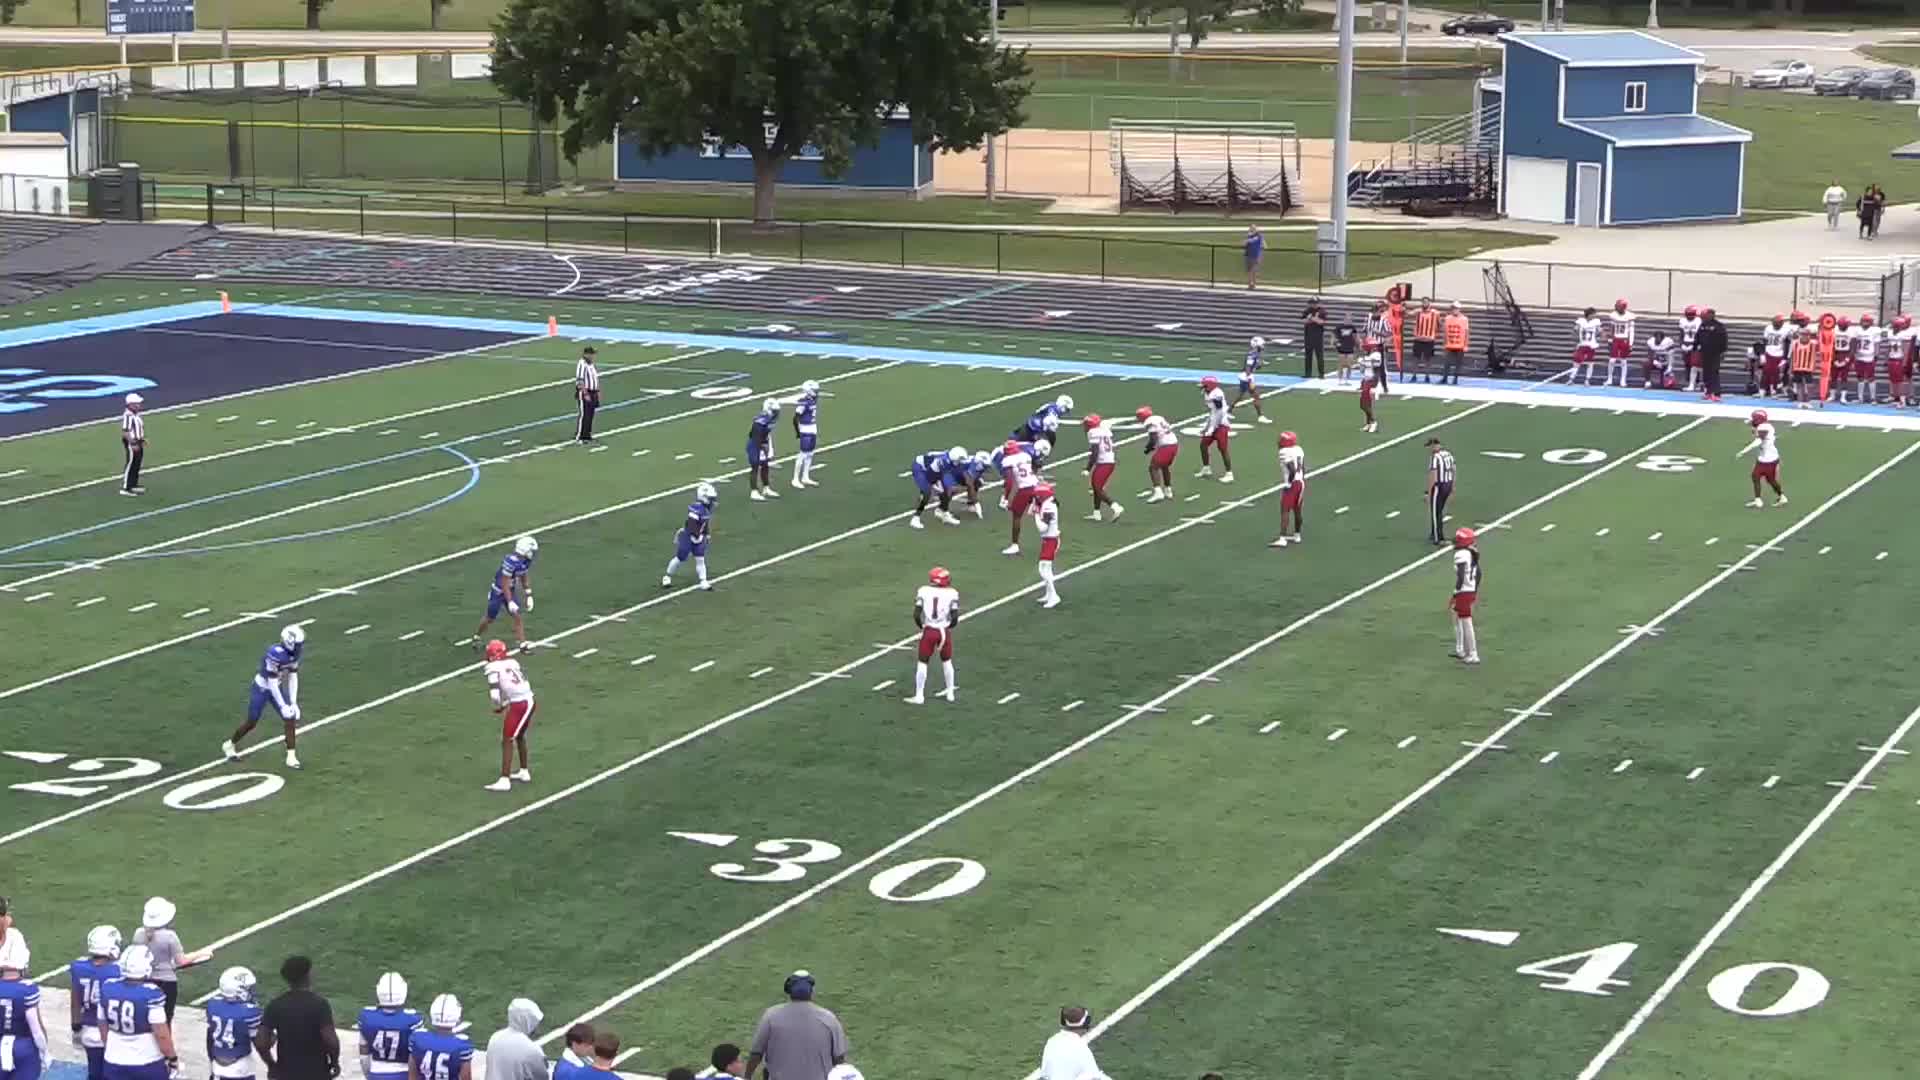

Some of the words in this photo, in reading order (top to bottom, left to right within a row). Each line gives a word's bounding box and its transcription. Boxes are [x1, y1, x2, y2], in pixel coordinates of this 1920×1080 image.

[710, 838, 987, 901] 30
[1516, 942, 1831, 1016] 40
[107, 999, 135, 1034] 58
[211, 1014, 235, 1049] 24
[372, 1030, 400, 1060] 47
